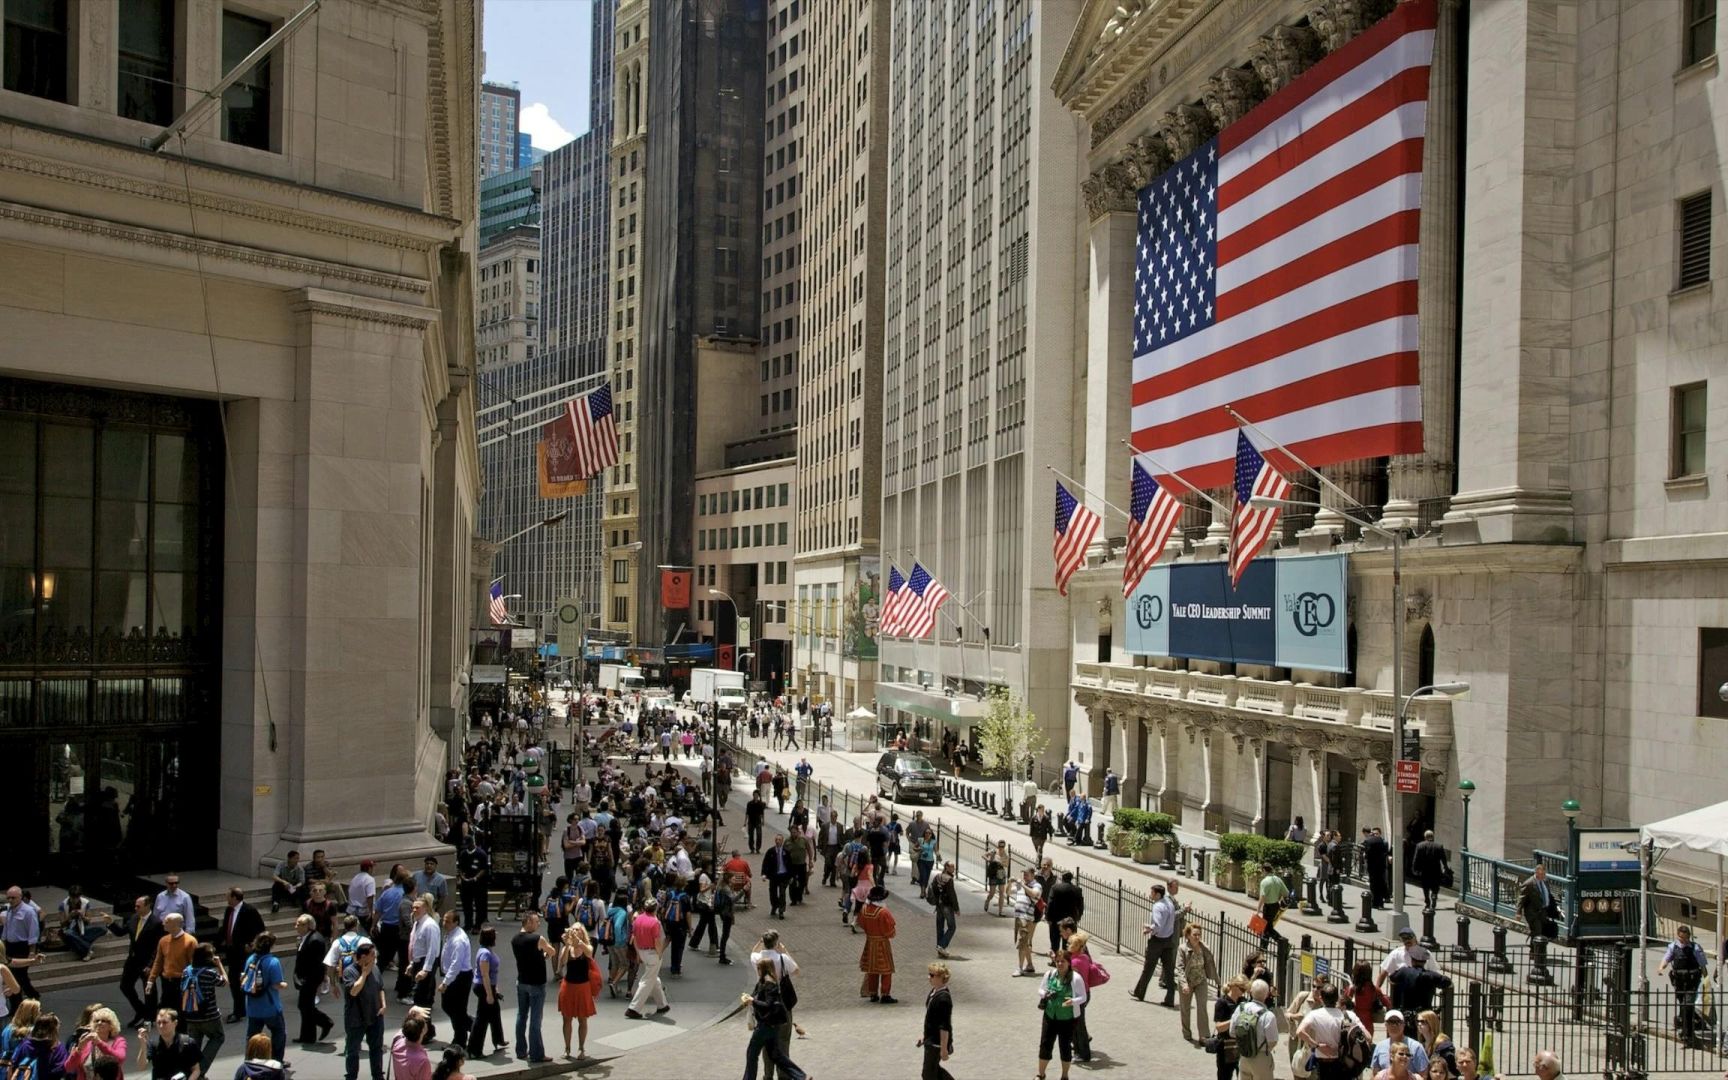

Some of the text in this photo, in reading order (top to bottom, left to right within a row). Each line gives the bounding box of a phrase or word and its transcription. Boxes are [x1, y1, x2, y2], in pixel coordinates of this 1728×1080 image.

[1187, 603, 1201, 618] CEO
[1202, 604, 1241, 619] LEADERSHIP
[1242, 604, 1271, 620] SUMMIT
[1581, 890, 1602, 898] Broad
[1604, 890, 1612, 898] St
[1598, 901, 1607, 910] M
